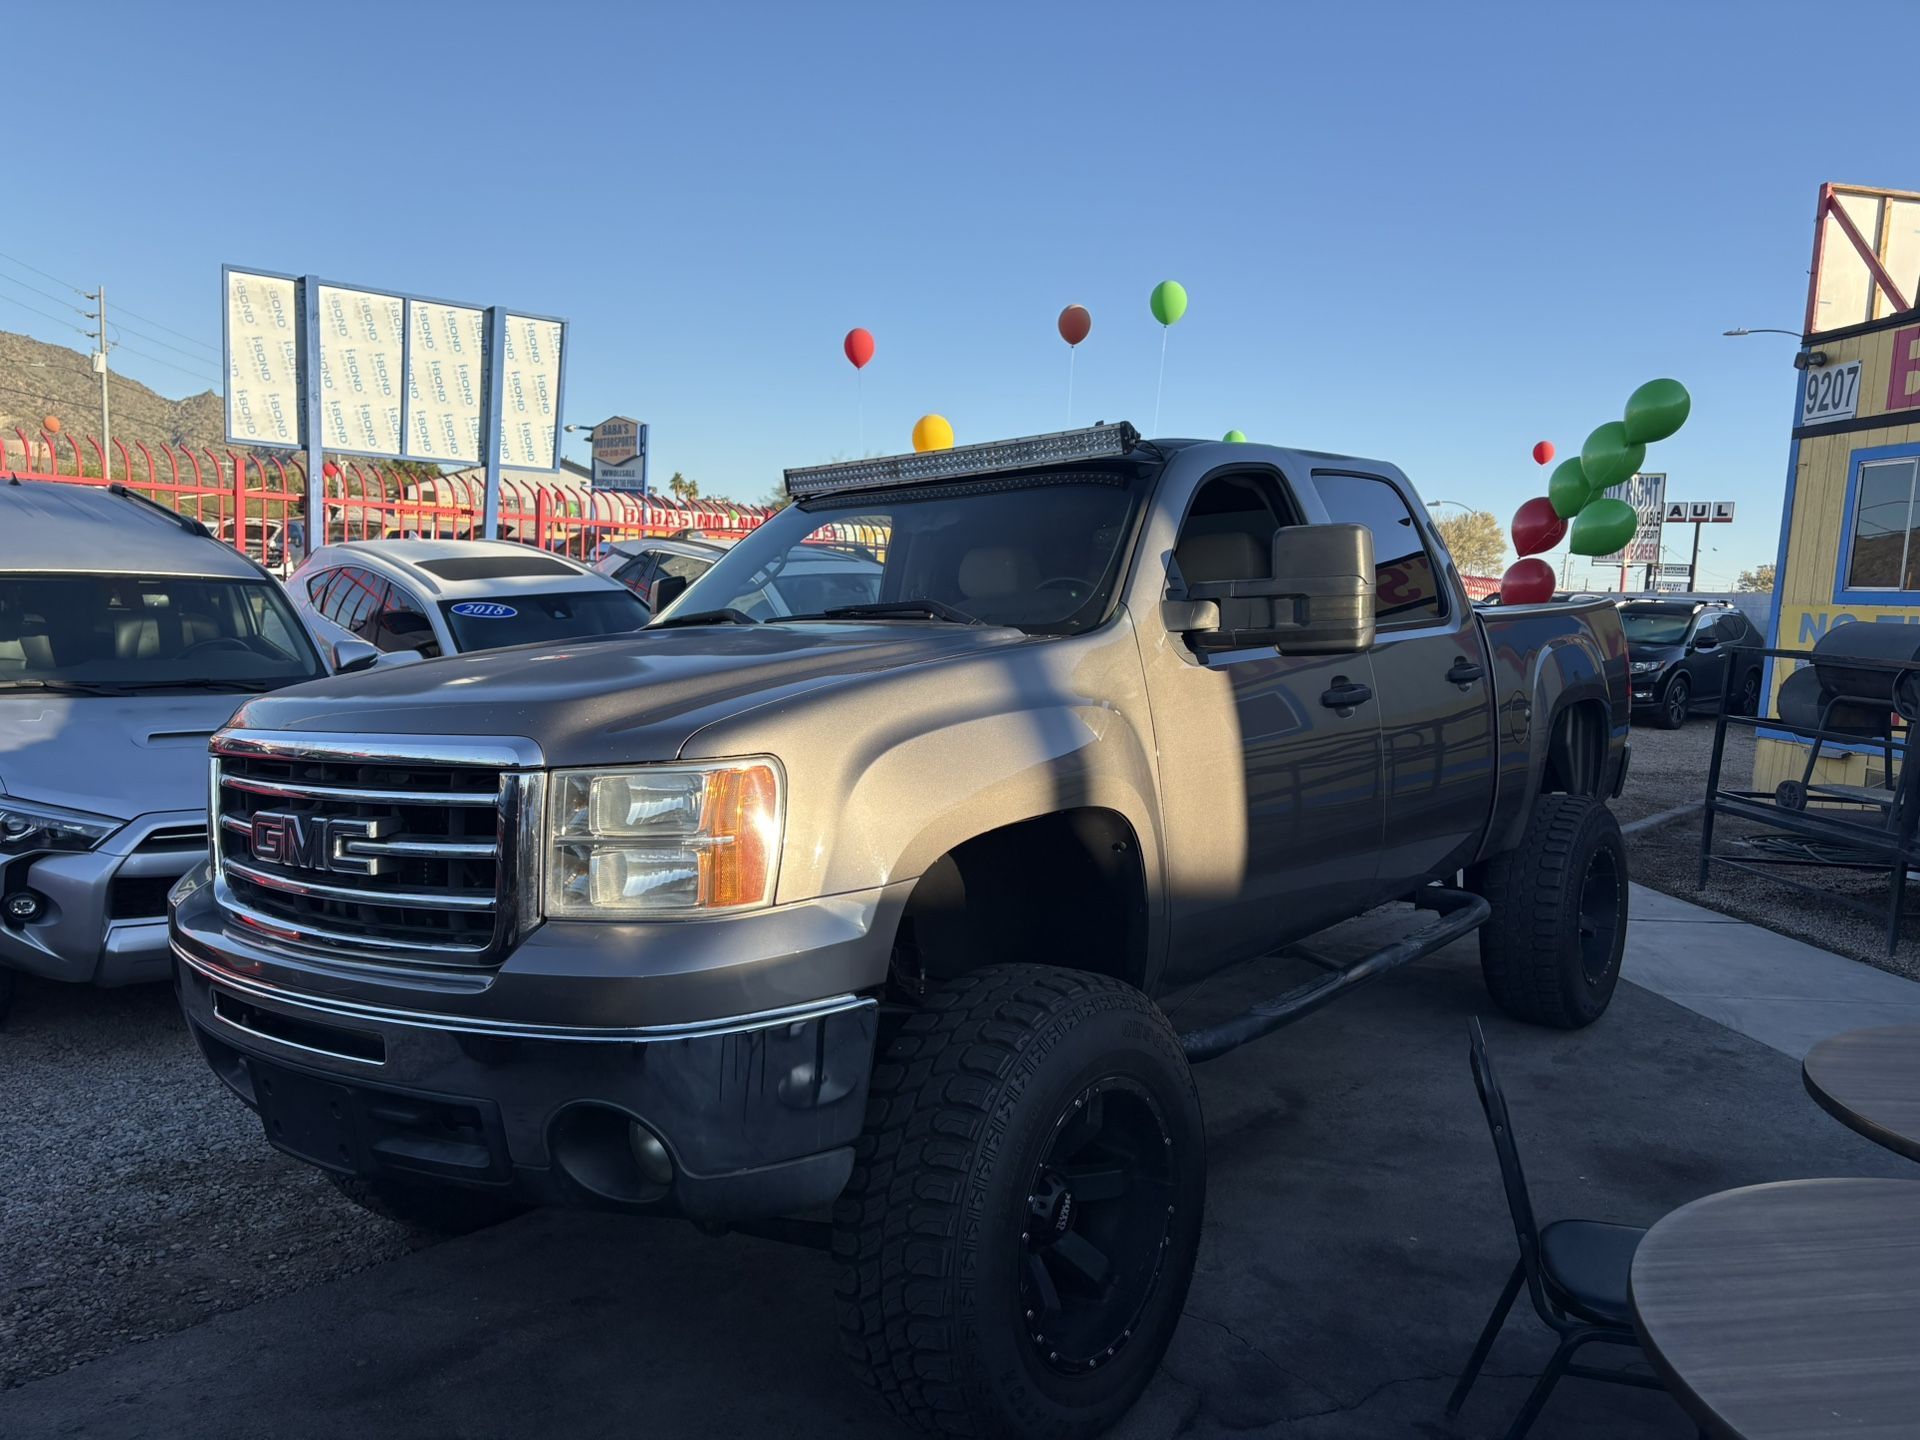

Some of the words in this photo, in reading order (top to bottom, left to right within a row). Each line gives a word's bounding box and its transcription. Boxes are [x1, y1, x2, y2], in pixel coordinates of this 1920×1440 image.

[1806, 366, 1859, 414] 9207
[602, 424, 629, 435] BABA'S
[1669, 505, 1728, 516] AUL
[463, 604, 505, 615] 2018
[251, 810, 379, 876] GMC
